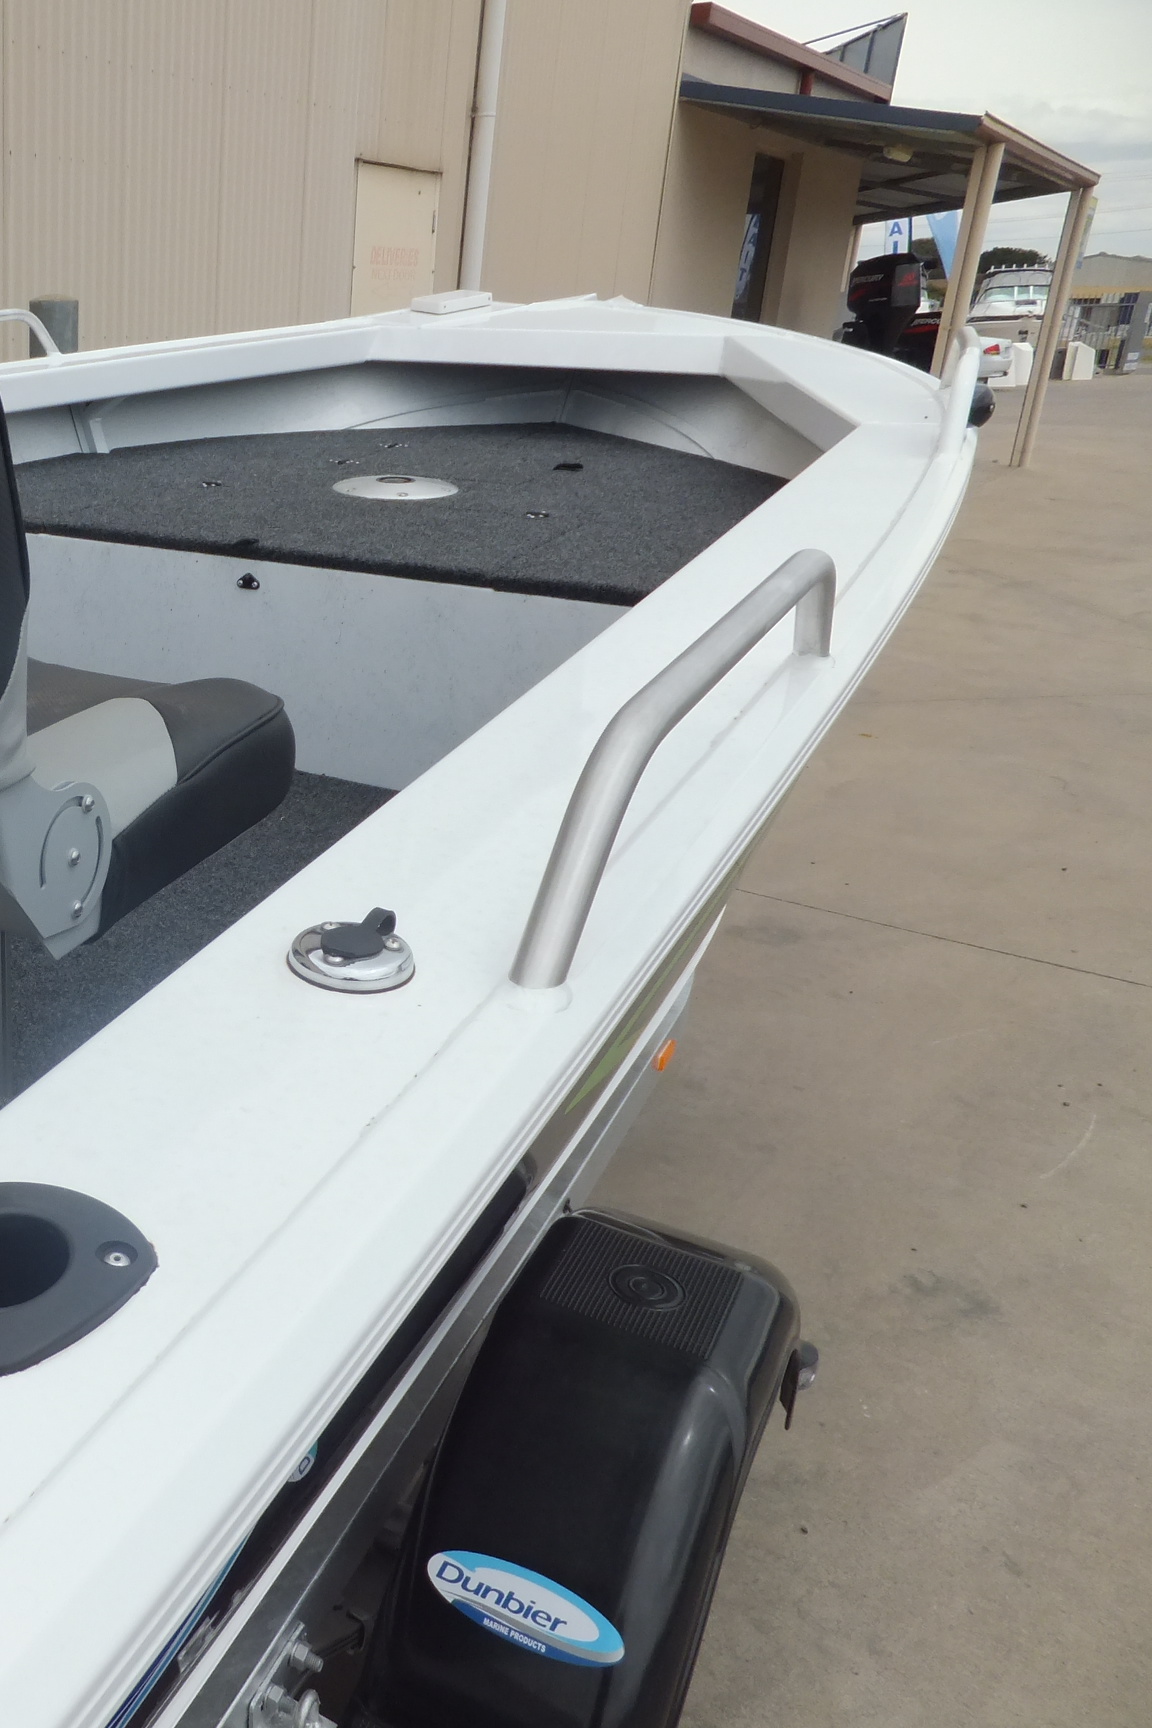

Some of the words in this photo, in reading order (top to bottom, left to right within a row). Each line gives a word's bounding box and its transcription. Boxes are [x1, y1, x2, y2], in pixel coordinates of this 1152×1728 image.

[435, 1559, 567, 1633] Dunbier
[482, 1616, 510, 1637] MARINE
[509, 1629, 547, 1653] PRODUCTS
